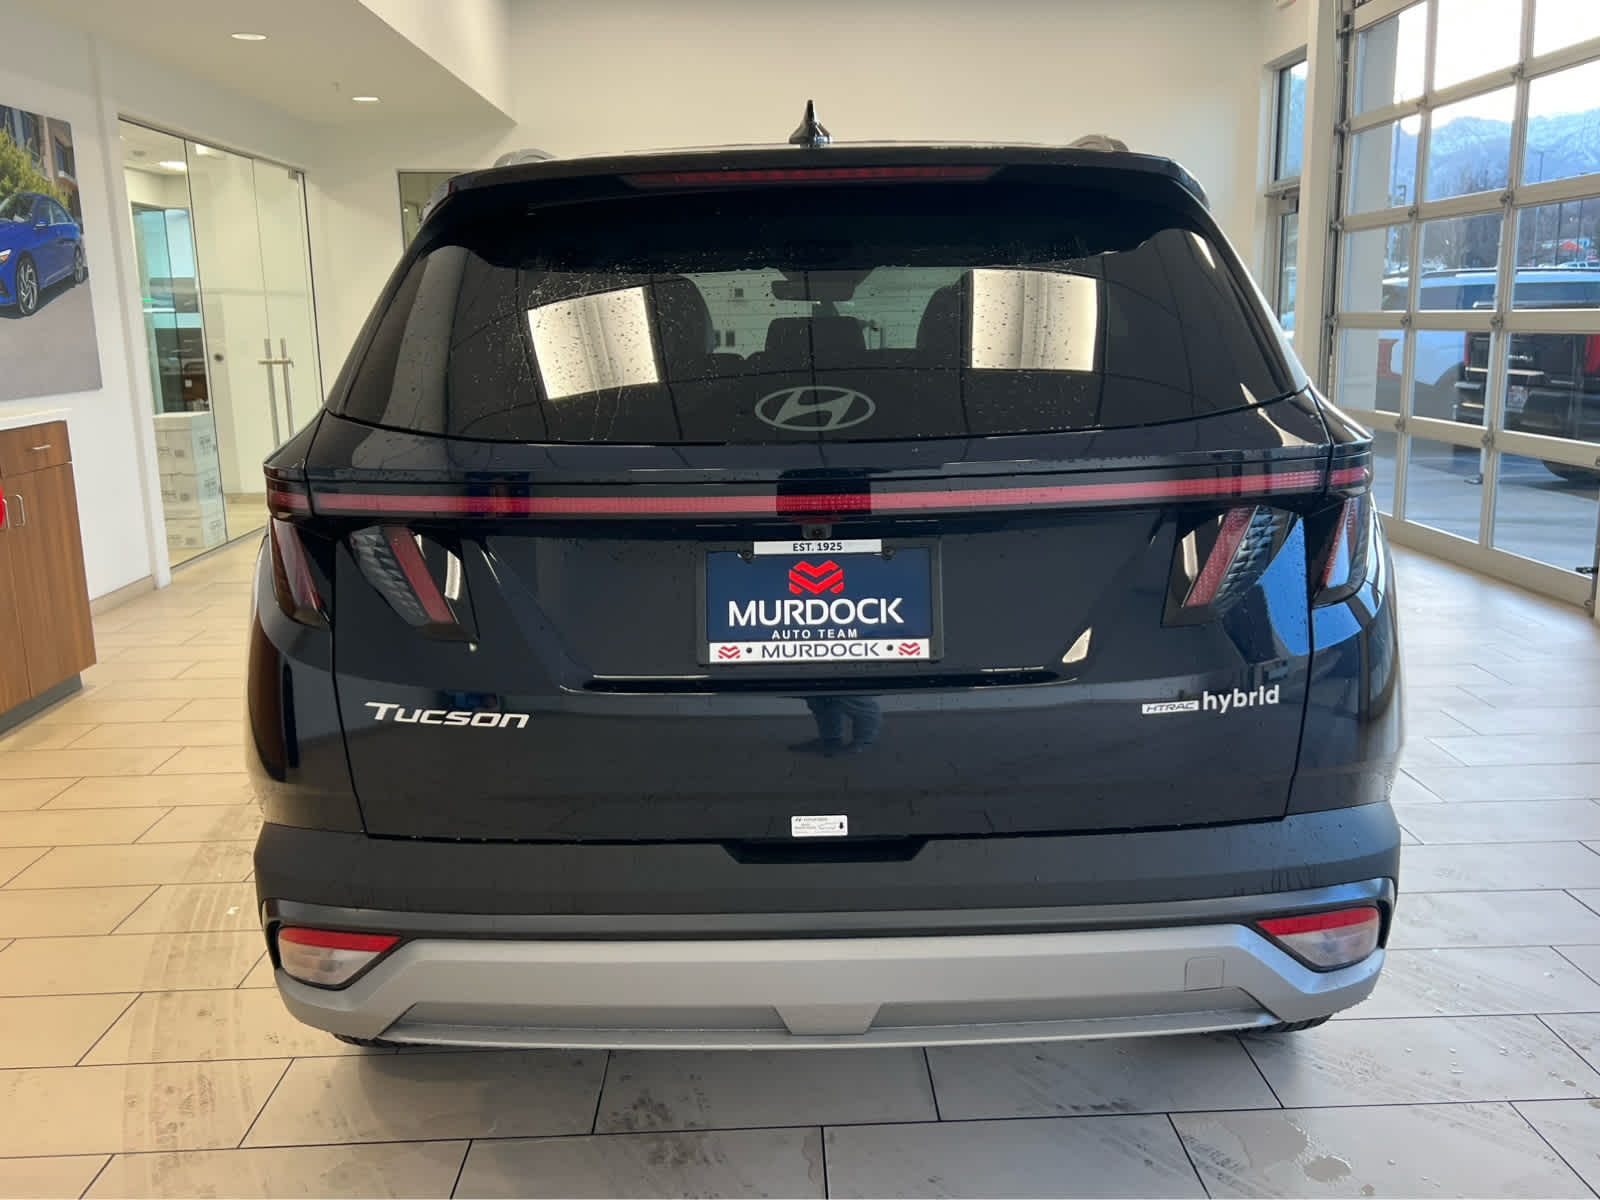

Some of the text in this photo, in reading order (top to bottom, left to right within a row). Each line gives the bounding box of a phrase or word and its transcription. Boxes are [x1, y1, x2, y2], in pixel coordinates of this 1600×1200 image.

[793, 541, 843, 552] EST. 1925
[728, 597, 905, 627] MURDOCK
[771, 628, 859, 640] AUTO TEAM
[761, 642, 881, 659] MURDOCK
[1202, 684, 1280, 714] hybrid
